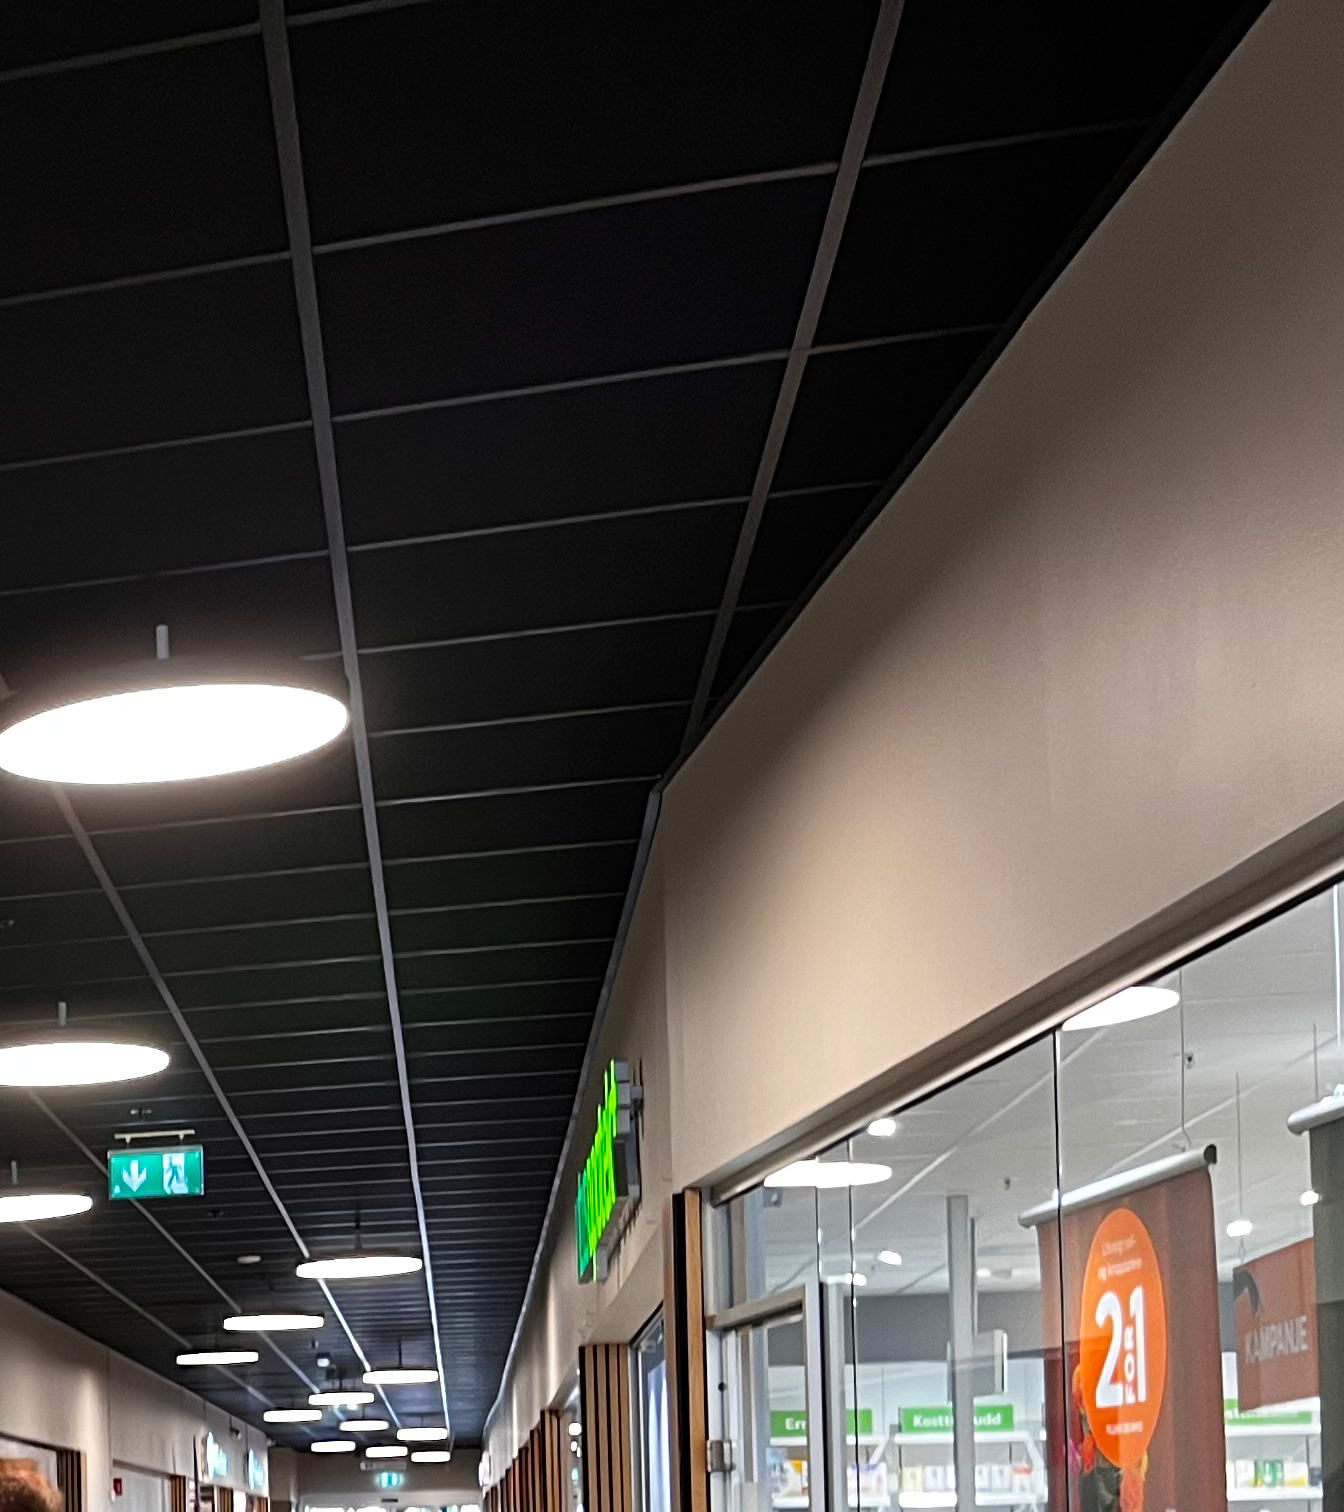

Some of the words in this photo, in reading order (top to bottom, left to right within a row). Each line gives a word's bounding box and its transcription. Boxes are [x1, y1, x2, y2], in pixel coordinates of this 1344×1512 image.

[1095, 1291, 1124, 1408] 2
[1129, 1285, 1147, 1402] 1
[1244, 1315, 1309, 1364] KAMPANJE
